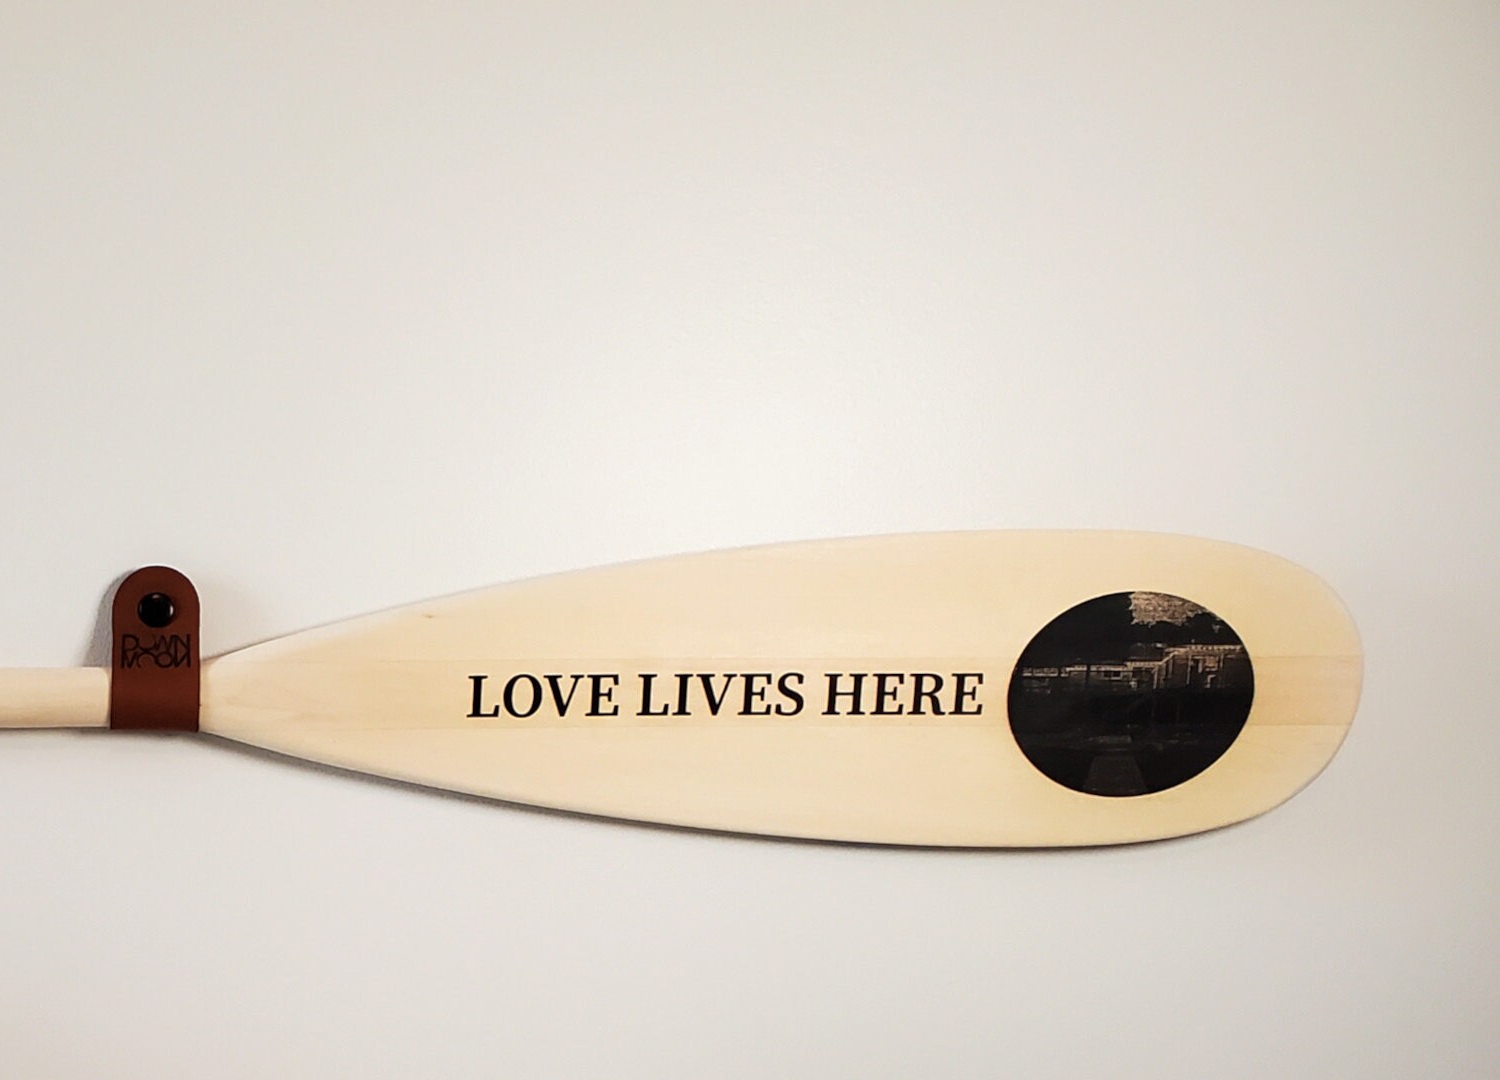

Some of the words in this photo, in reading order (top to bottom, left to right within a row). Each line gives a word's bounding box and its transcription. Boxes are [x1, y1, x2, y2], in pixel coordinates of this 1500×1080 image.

[466, 674, 619, 718] LOVE
[635, 673, 804, 717] LIVES
[821, 673, 984, 716] HERE
